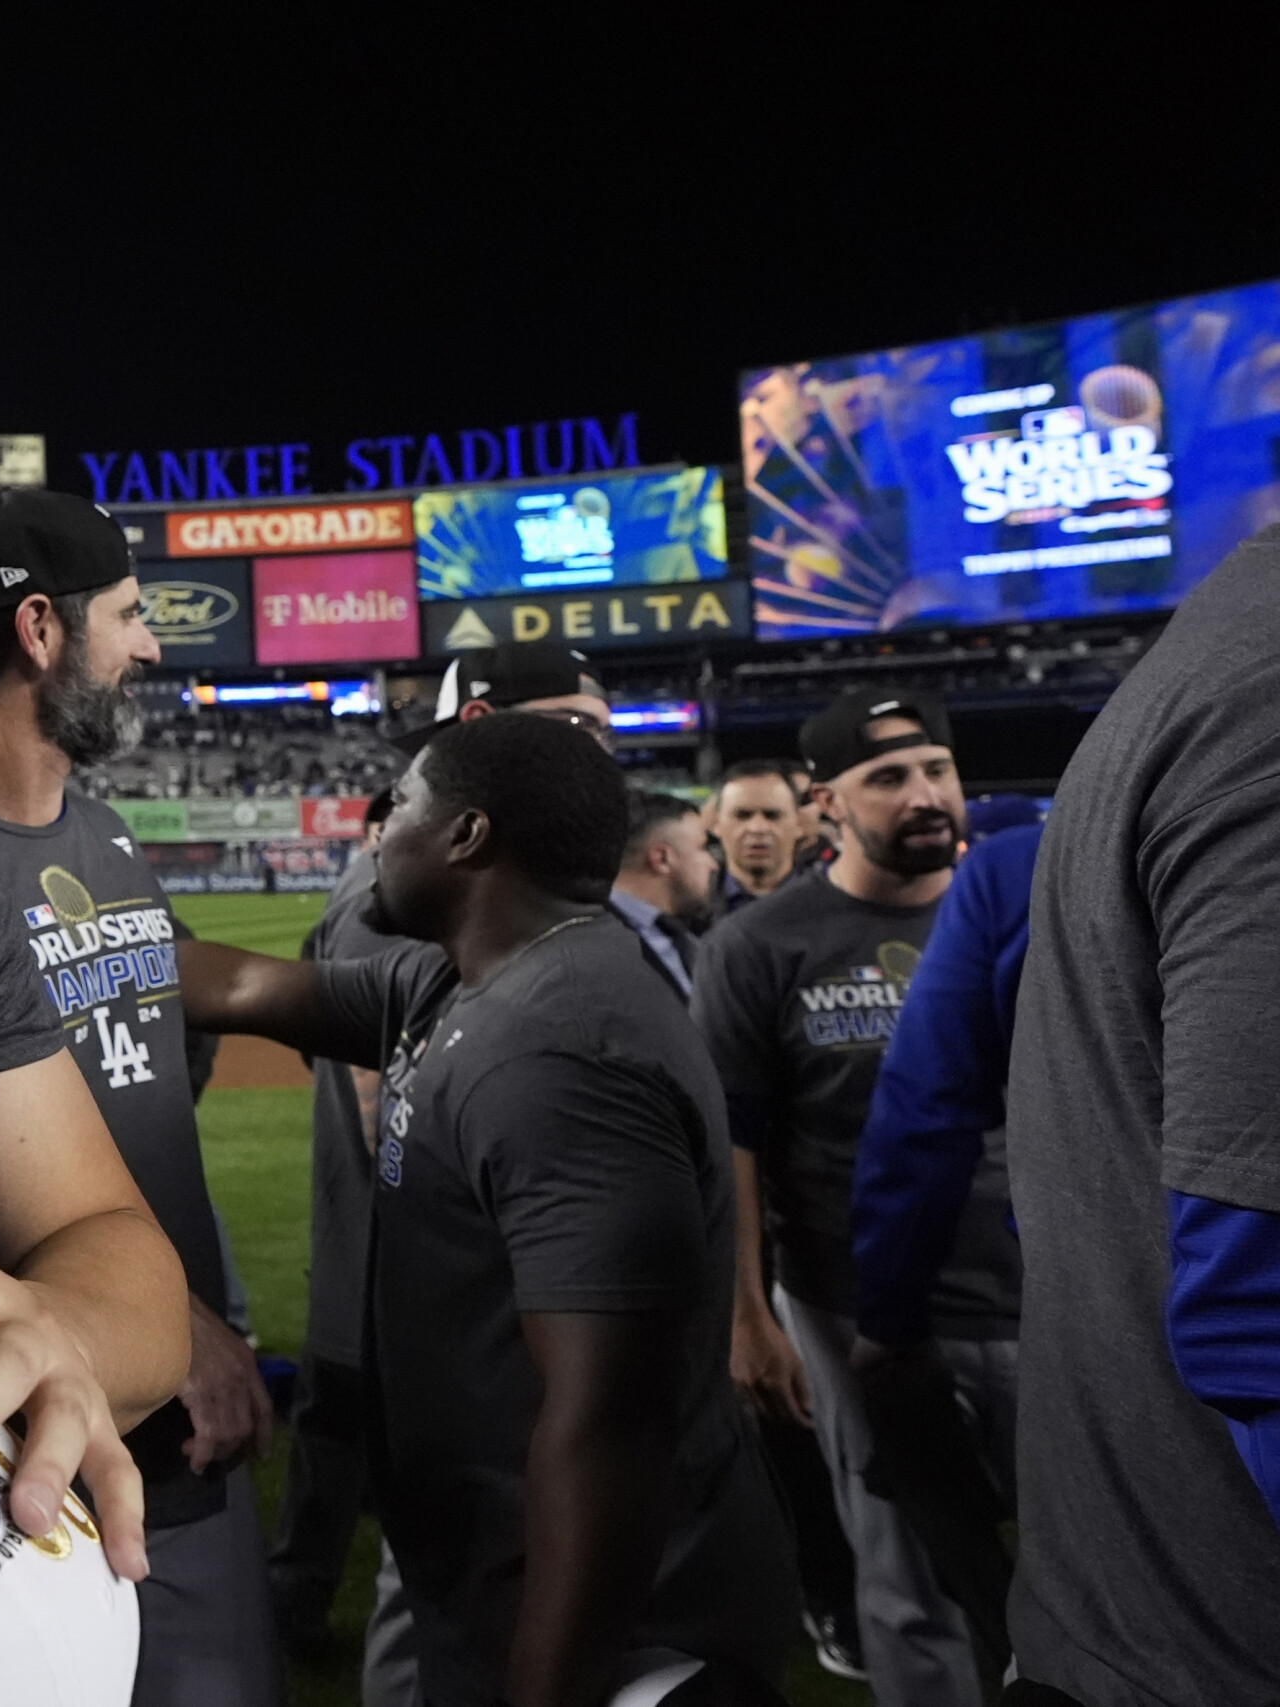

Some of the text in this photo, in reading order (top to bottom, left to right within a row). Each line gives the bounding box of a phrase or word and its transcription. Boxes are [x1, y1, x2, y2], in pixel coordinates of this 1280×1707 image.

[79, 443, 312, 504] YANKEE
[345, 412, 642, 492] STADIUM
[946, 425, 1157, 484] WORLD
[961, 453, 1174, 524] SERIES
[180, 504, 403, 550] GATORADE
[138, 588, 216, 624] Ford
[299, 589, 409, 626] Mobile
[513, 592, 731, 642] DELTA
[29, 908, 174, 970] RLD SERIES
[137, 1005, 162, 1022] 24
[801, 982, 910, 1012] WORL
[92, 1005, 156, 1088] LA
